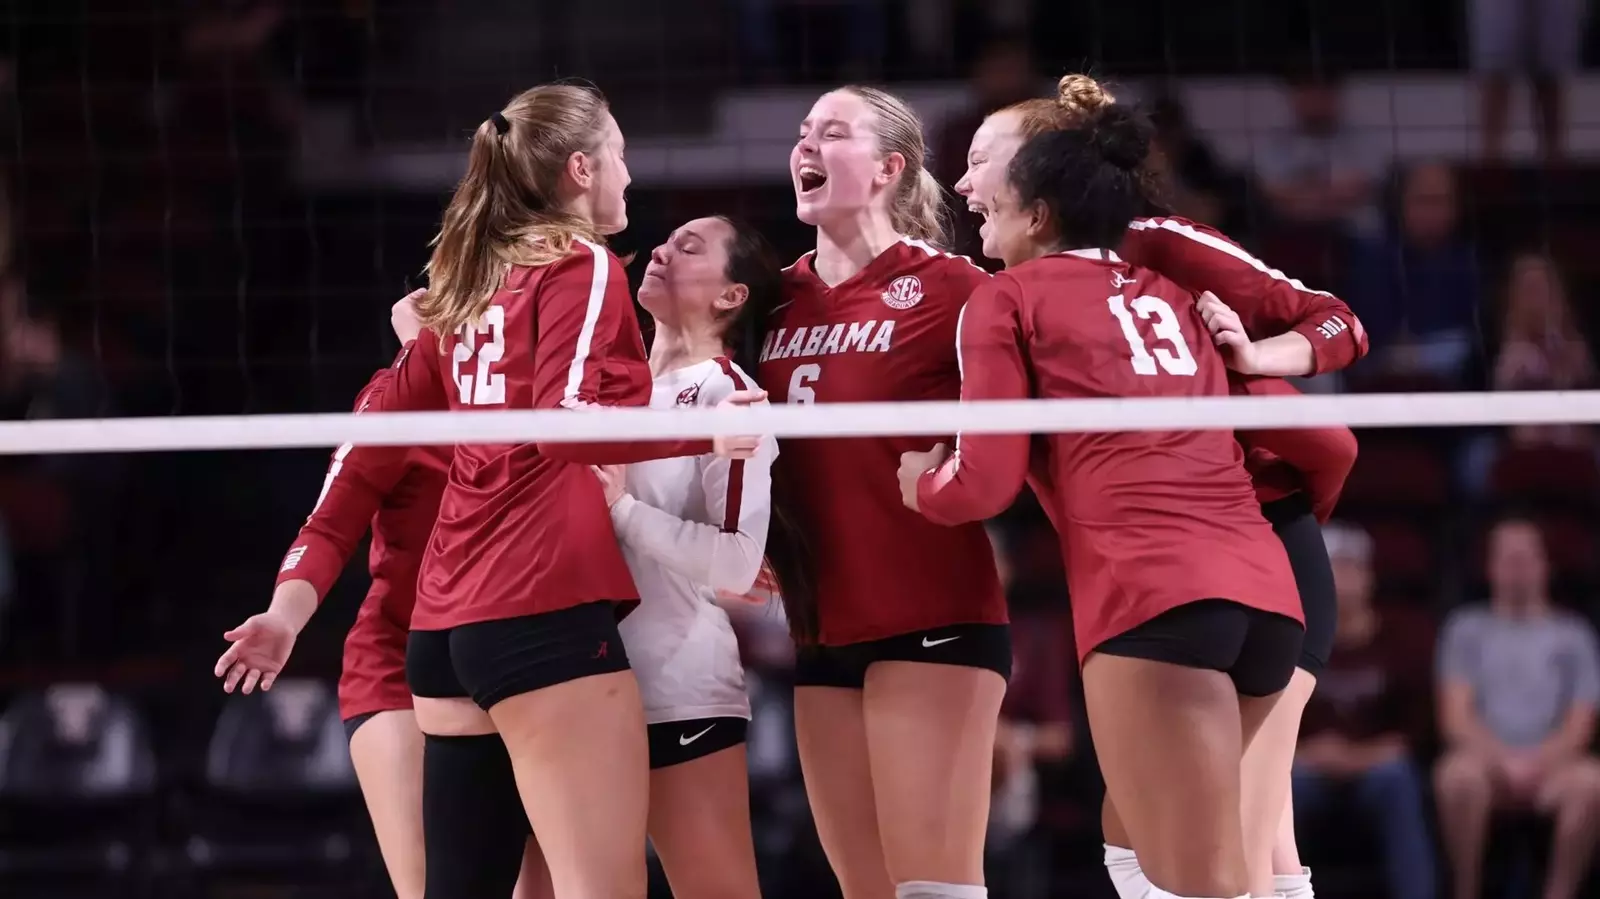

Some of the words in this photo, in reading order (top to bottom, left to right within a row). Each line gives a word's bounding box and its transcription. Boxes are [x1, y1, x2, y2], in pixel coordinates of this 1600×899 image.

[891, 277, 919, 301] SEC
[758, 320, 896, 363] ALABAMA
[1106, 294, 1199, 376] 13
[1315, 315, 1348, 339] TIDE
[452, 305, 506, 405] 22
[787, 363, 821, 405] 6
